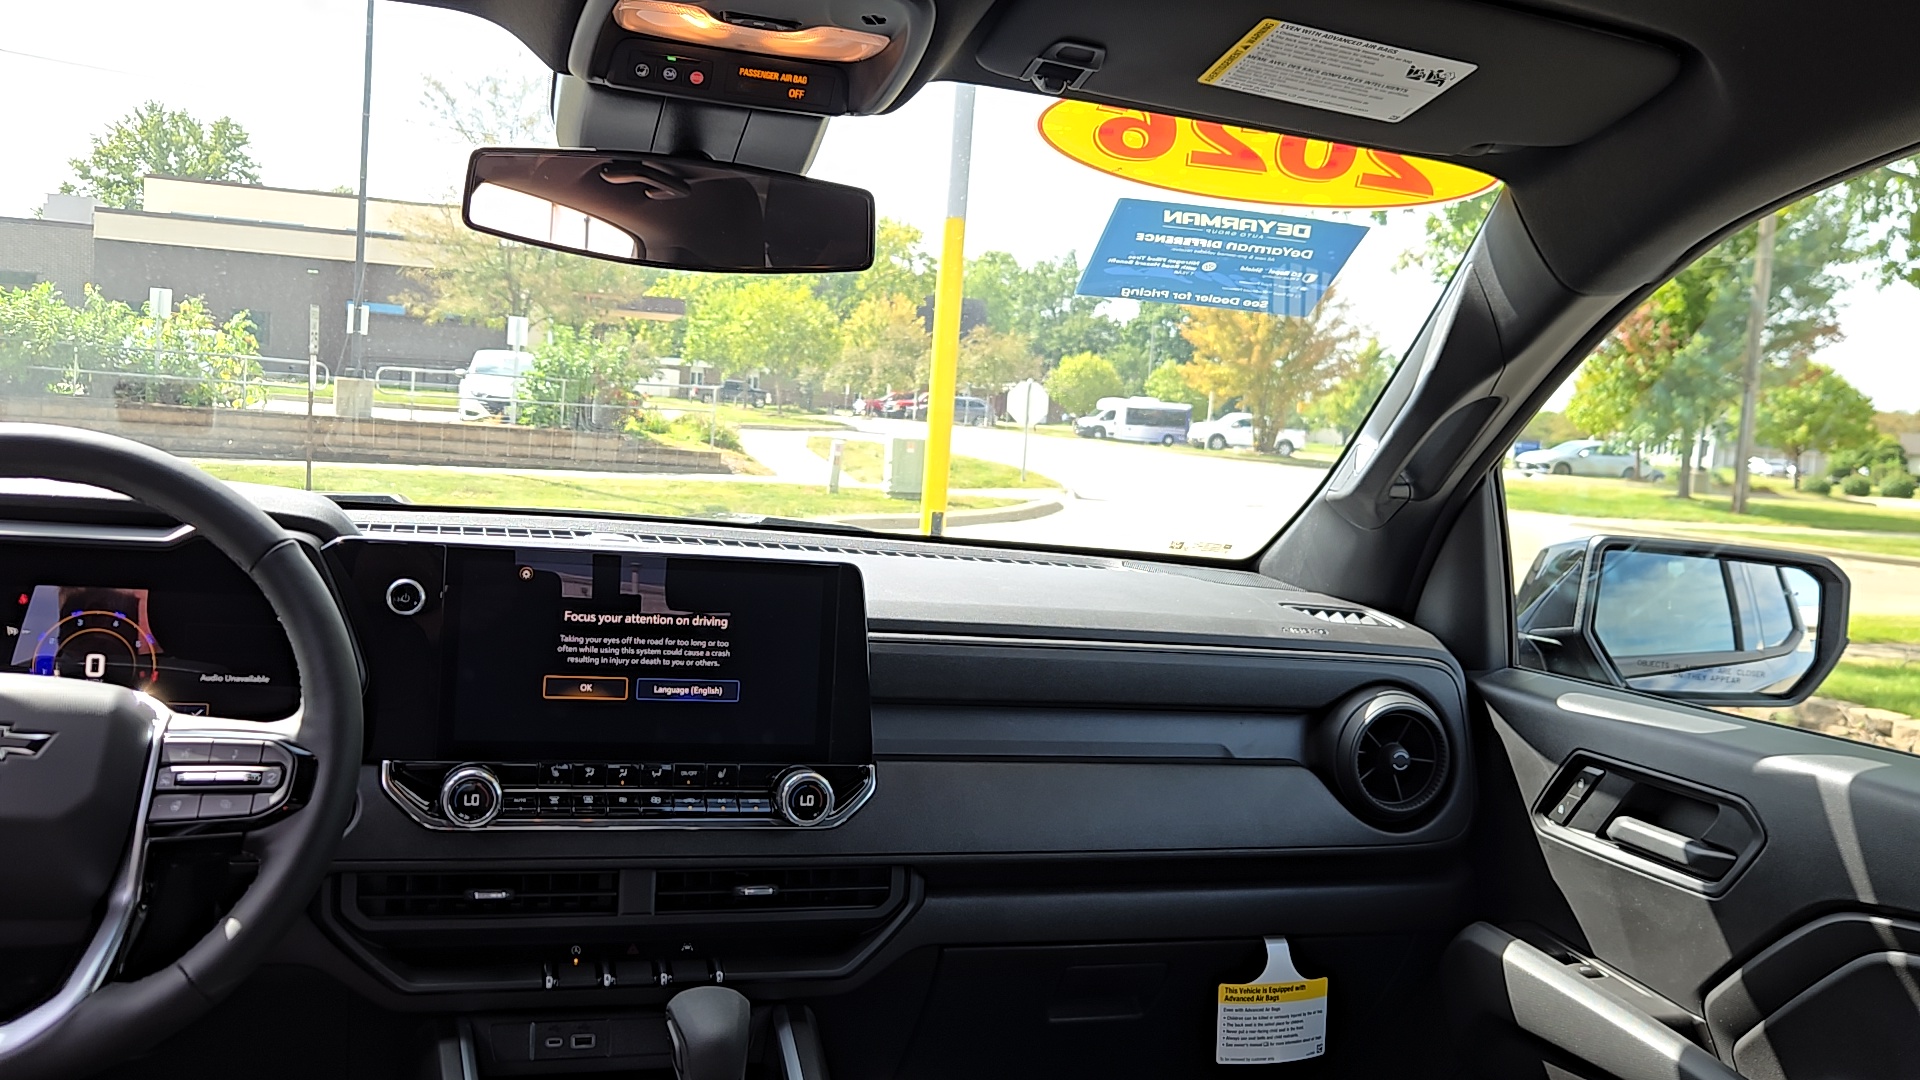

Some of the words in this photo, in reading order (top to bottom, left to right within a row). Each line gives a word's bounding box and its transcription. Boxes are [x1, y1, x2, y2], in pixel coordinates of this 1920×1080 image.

[1281, 24, 1301, 32] EVEN
[1301, 28, 1322, 36] WITH
[1322, 33, 1363, 45] ADVANCED
[1377, 45, 1399, 54] BAGS
[739, 68, 779, 81] PASSENGER
[780, 74, 791, 82] AIR
[792, 75, 807, 84] BAG
[788, 89, 804, 99] OFF
[564, 610, 596, 623] Focus
[598, 614, 621, 625] your
[625, 614, 673, 626] attention
[676, 617, 689, 626] on
[692, 616, 728, 629] driving
[560, 634, 584, 645] Taking
[585, 637, 601, 645] your
[603, 637, 620, 646] eyes
[621, 636, 632, 644] off
[634, 636, 645, 645] the
[647, 637, 663, 645] road
[664, 637, 676, 646] for
[690, 638, 706, 648] long
[557, 644, 577, 653] often
[579, 645, 598, 653] while
[600, 646, 619, 655] using
[621, 646, 634, 654] this
[636, 648, 661, 656] system
[663, 647, 682, 656] could
[712, 649, 730, 657] crash
[85, 654, 106, 677] 0
[567, 656, 599, 666] resulting
[609, 657, 630, 666] injury
[695, 658, 719, 666] others.
[1637, 660, 1669, 668] OBJECTS
[1737, 669, 1766, 678] CLOSER
[200, 674, 222, 682] Audio
[225, 675, 270, 684] Unavailable
[580, 684, 592, 692] OK
[654, 685, 689, 695] Language
[690, 686, 722, 696] (English)
[464, 794, 479, 807] LO
[800, 794, 814, 806] LO
